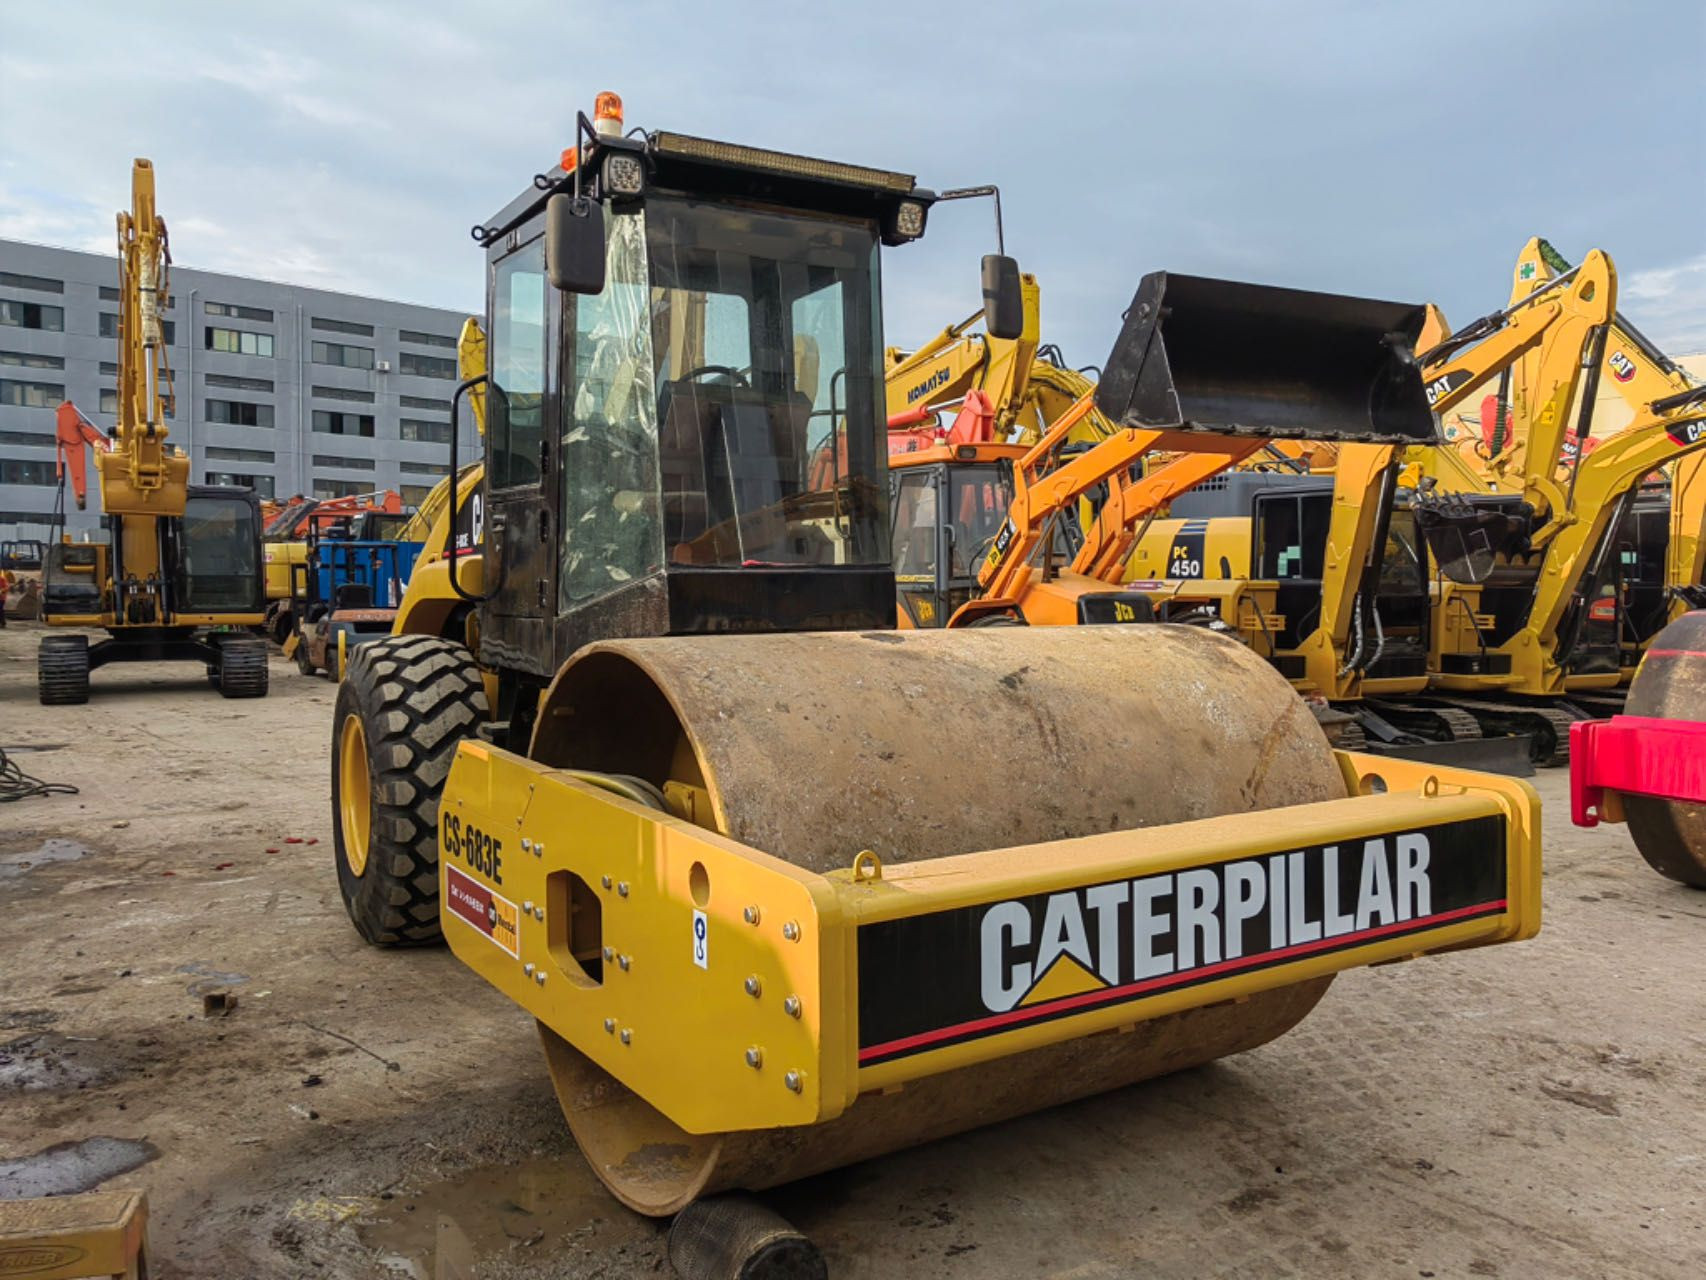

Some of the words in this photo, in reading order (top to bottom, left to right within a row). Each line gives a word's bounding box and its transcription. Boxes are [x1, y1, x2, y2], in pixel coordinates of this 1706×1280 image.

[1609, 352, 1633, 376] CAT
[908, 366, 950, 404] KOMATSU
[1425, 375, 1451, 404] CAT
[1687, 420, 1706, 442] CA
[1173, 546, 1188, 559] PC
[1170, 560, 1201, 577] 450
[1113, 600, 1136, 623] JCB
[443, 811, 503, 886] CS-683E
[980, 832, 1431, 1014] CATERPILLAR
